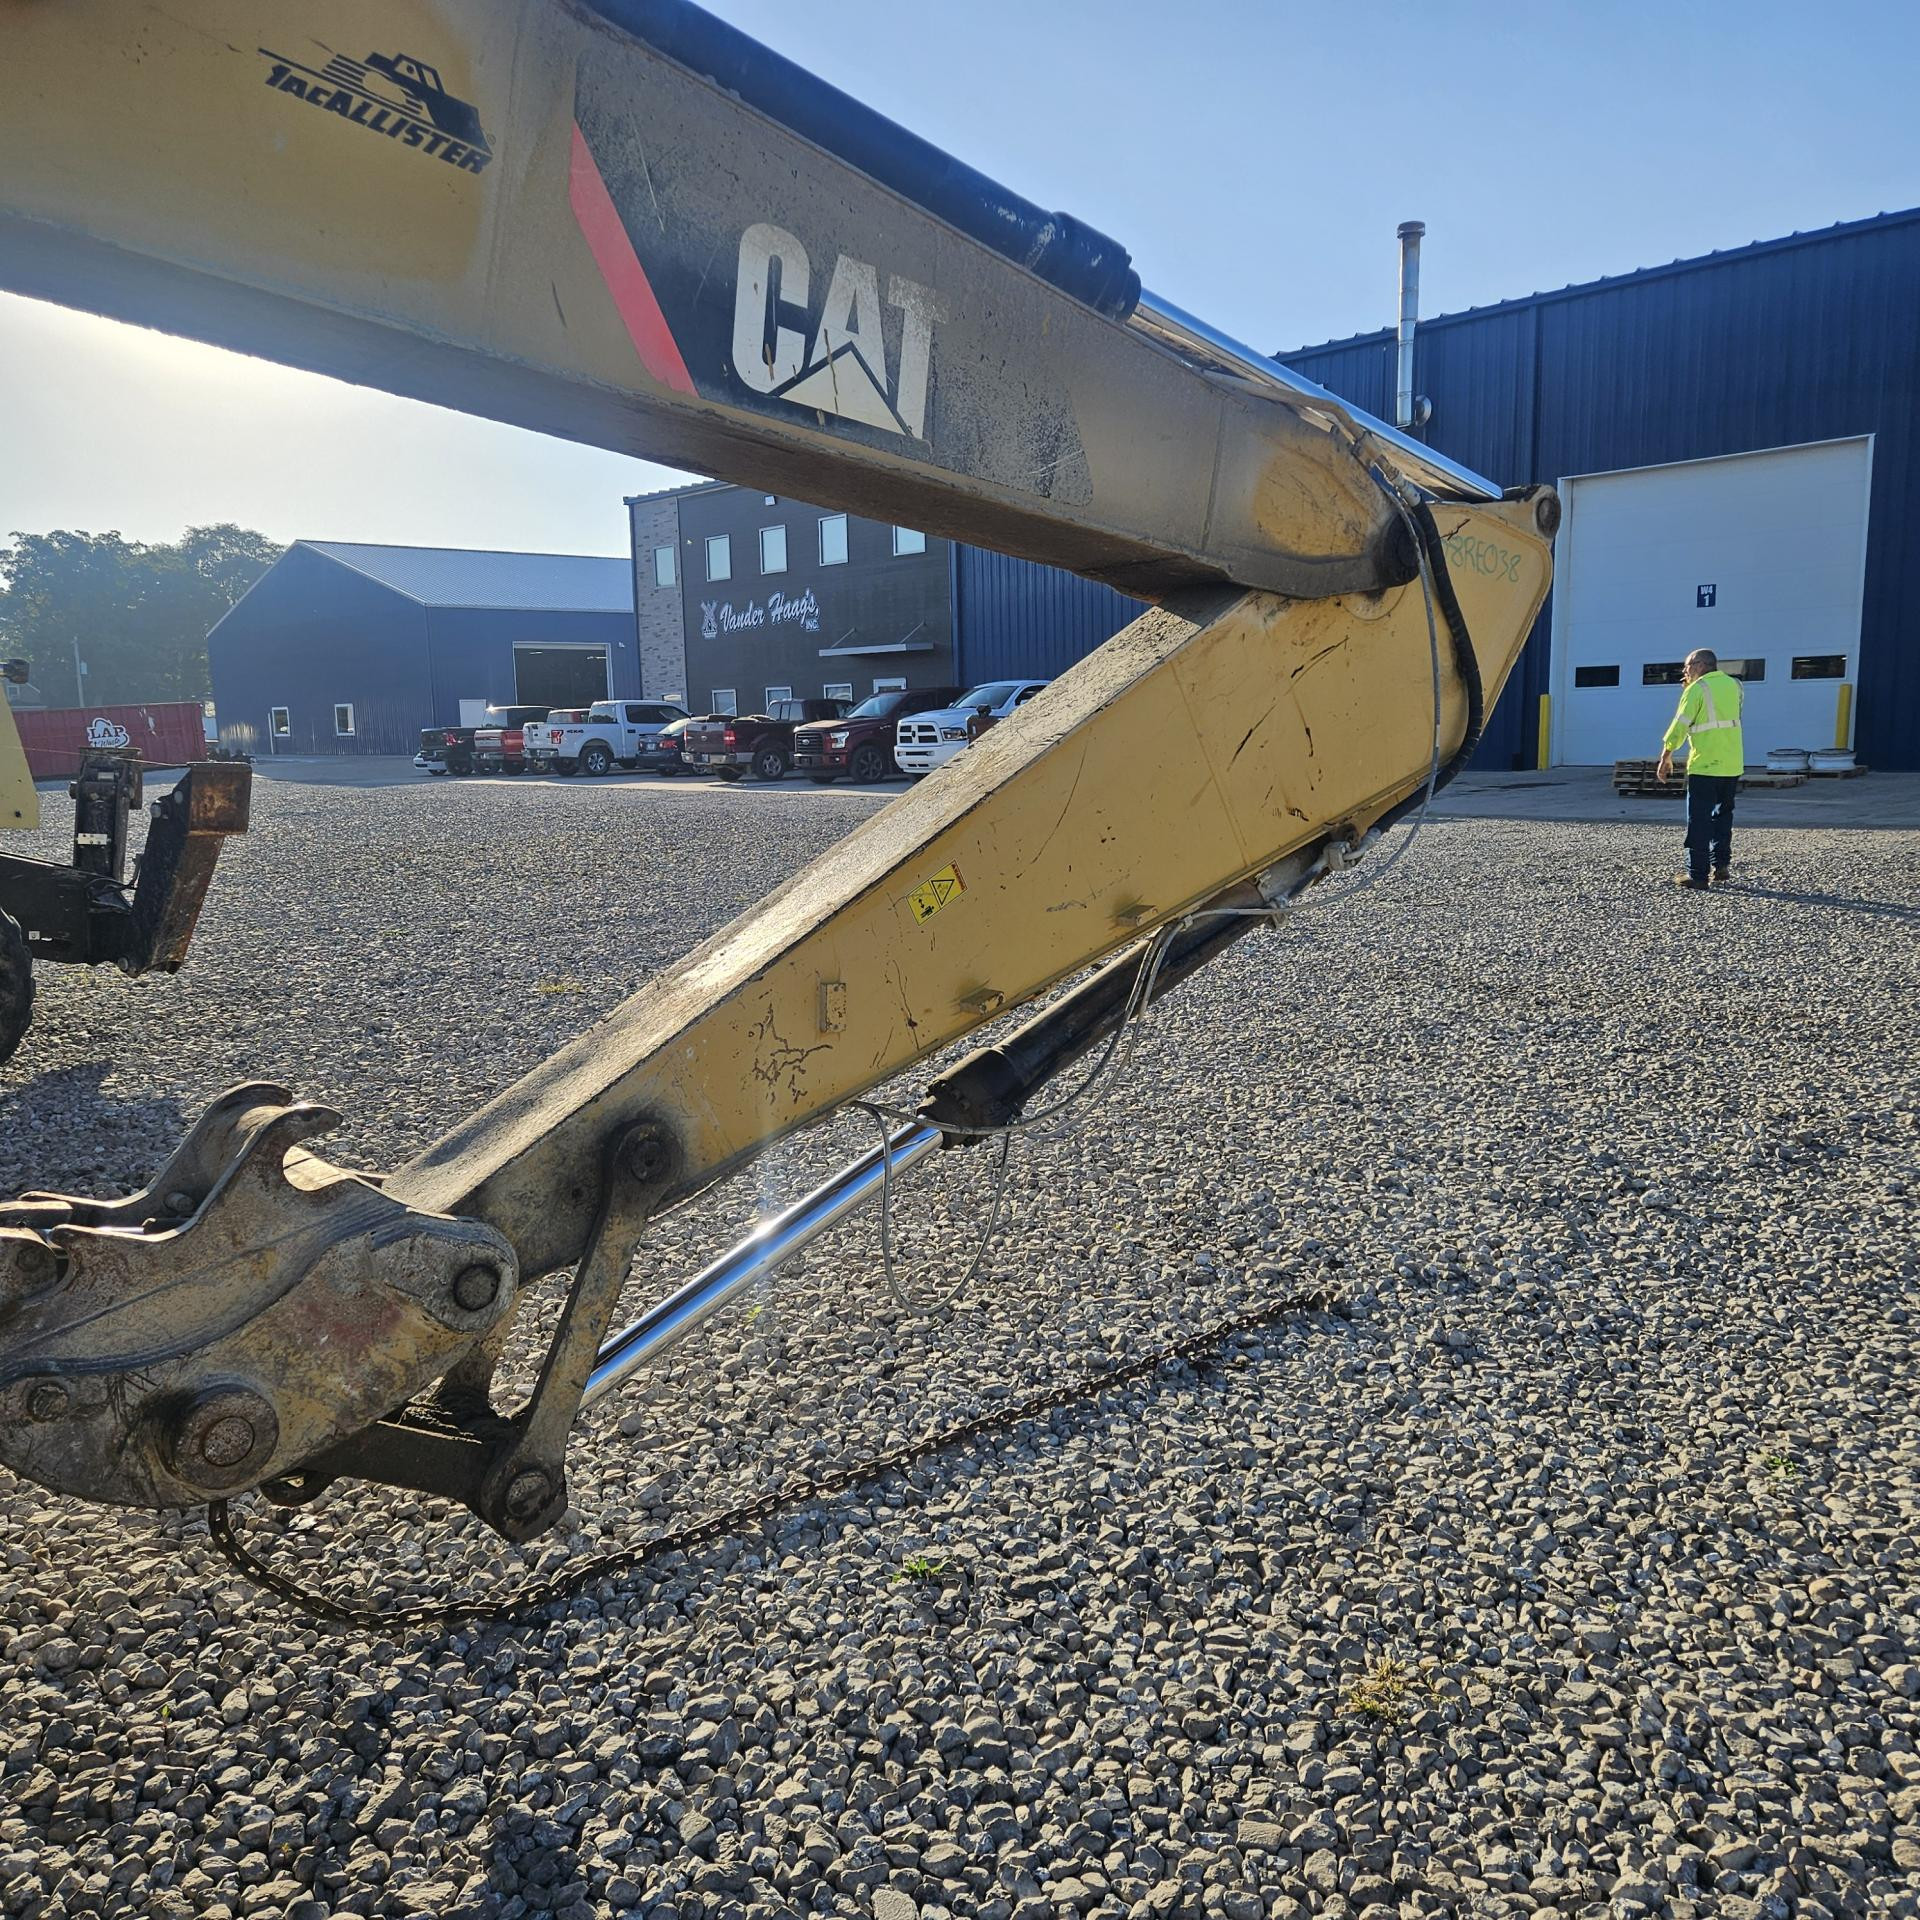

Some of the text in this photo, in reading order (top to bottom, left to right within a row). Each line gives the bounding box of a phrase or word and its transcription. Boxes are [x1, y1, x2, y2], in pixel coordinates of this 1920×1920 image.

[732, 222, 949, 440] CAT
[1703, 594, 1710, 607] 1
[719, 599, 765, 634] Vander
[89, 727, 124, 739] LAP
